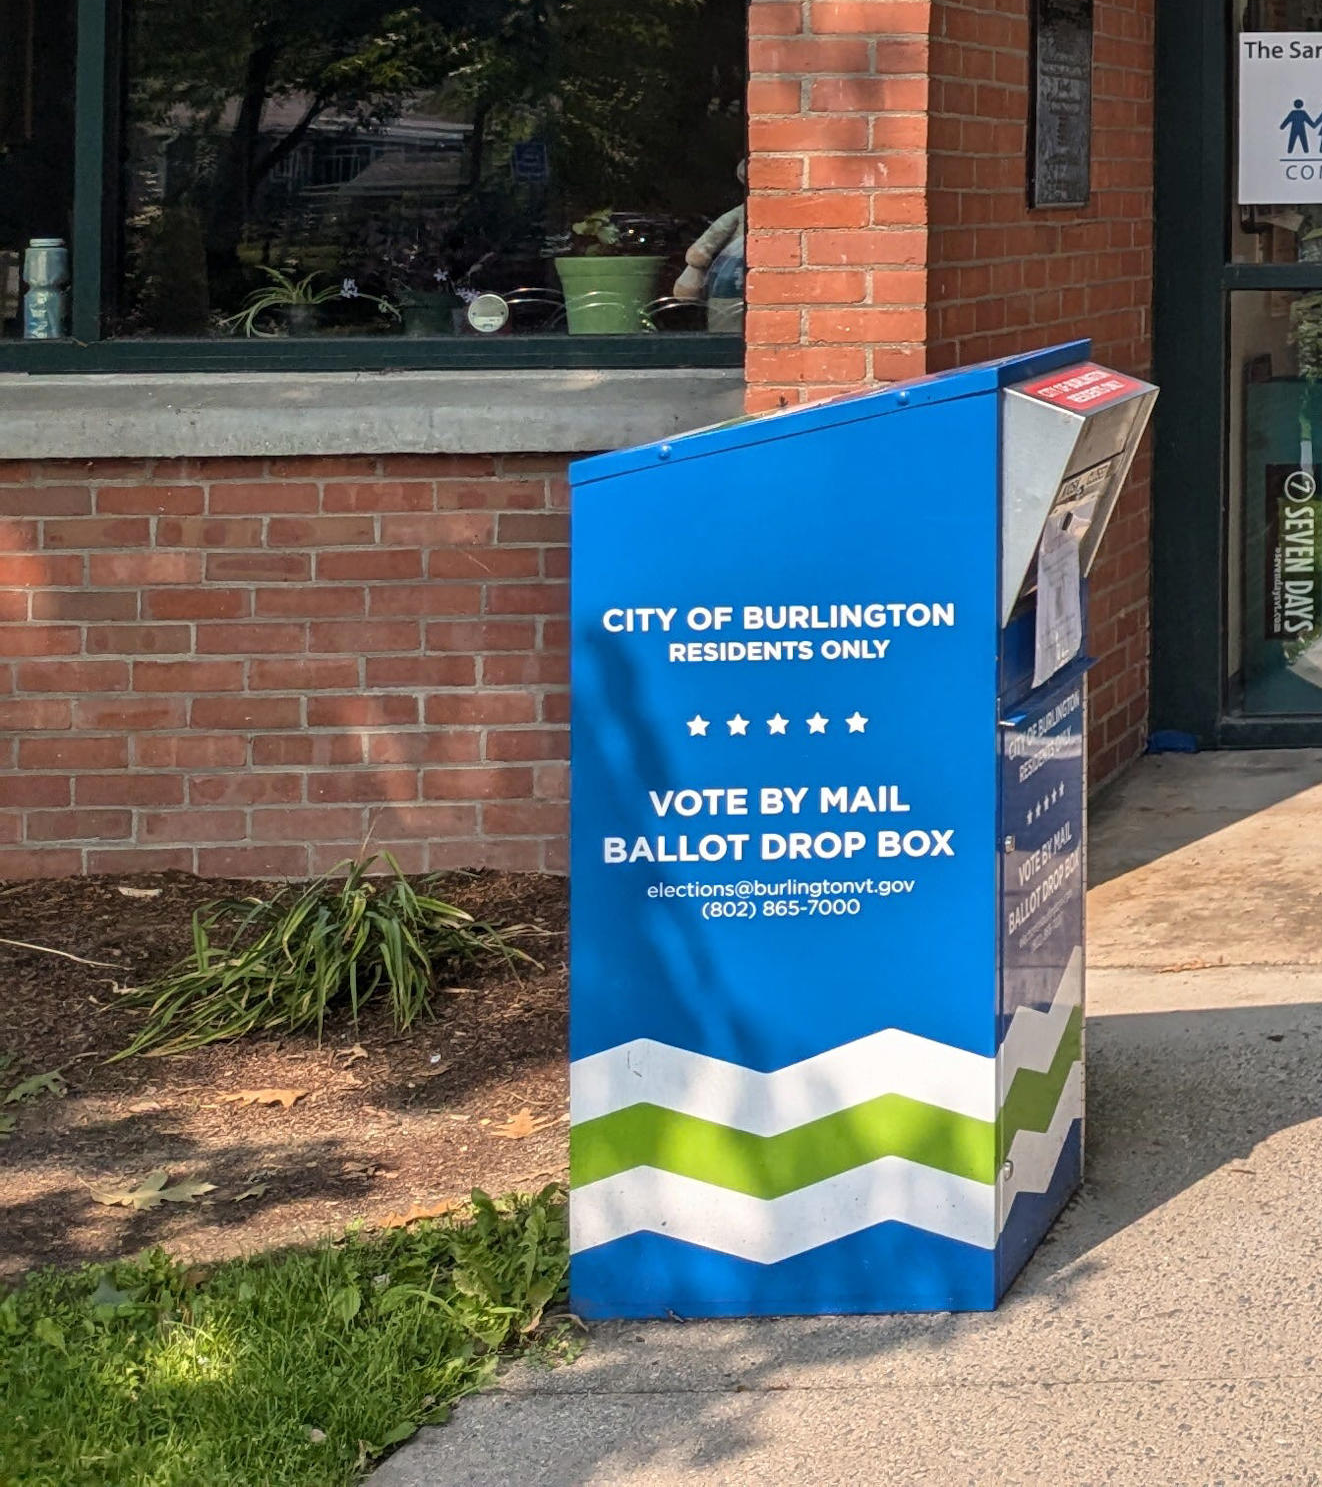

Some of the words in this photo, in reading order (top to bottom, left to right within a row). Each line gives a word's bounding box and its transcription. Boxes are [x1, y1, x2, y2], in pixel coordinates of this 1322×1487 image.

[1244, 41, 1284, 59] The
[1285, 506, 1315, 573] SEVEN
[602, 607, 678, 633] CITY
[687, 606, 734, 631] OF
[743, 602, 955, 630] BURLINGTON
[1284, 580, 1315, 633] DAYS
[669, 640, 813, 663] RESIDENTS
[821, 639, 891, 660] ONLY
[649, 788, 748, 817] VOTE
[760, 787, 810, 815] BY
[820, 785, 911, 813] MAIL
[603, 833, 751, 864] BALLOT
[762, 831, 867, 861] DROP
[878, 829, 956, 858] BOX
[1018, 849, 1041, 886] VOTE
[1042, 838, 1053, 867] BY
[1054, 821, 1072, 854] MAIL
[647, 877, 915, 900] elections@burlingtonvt.gov
[1008, 885, 1042, 935] BALLOT
[1042, 863, 1064, 902] DROP
[1065, 839, 1081, 879] BOX
[702, 900, 757, 920] (802)
[762, 898, 861, 918] 865-7000
